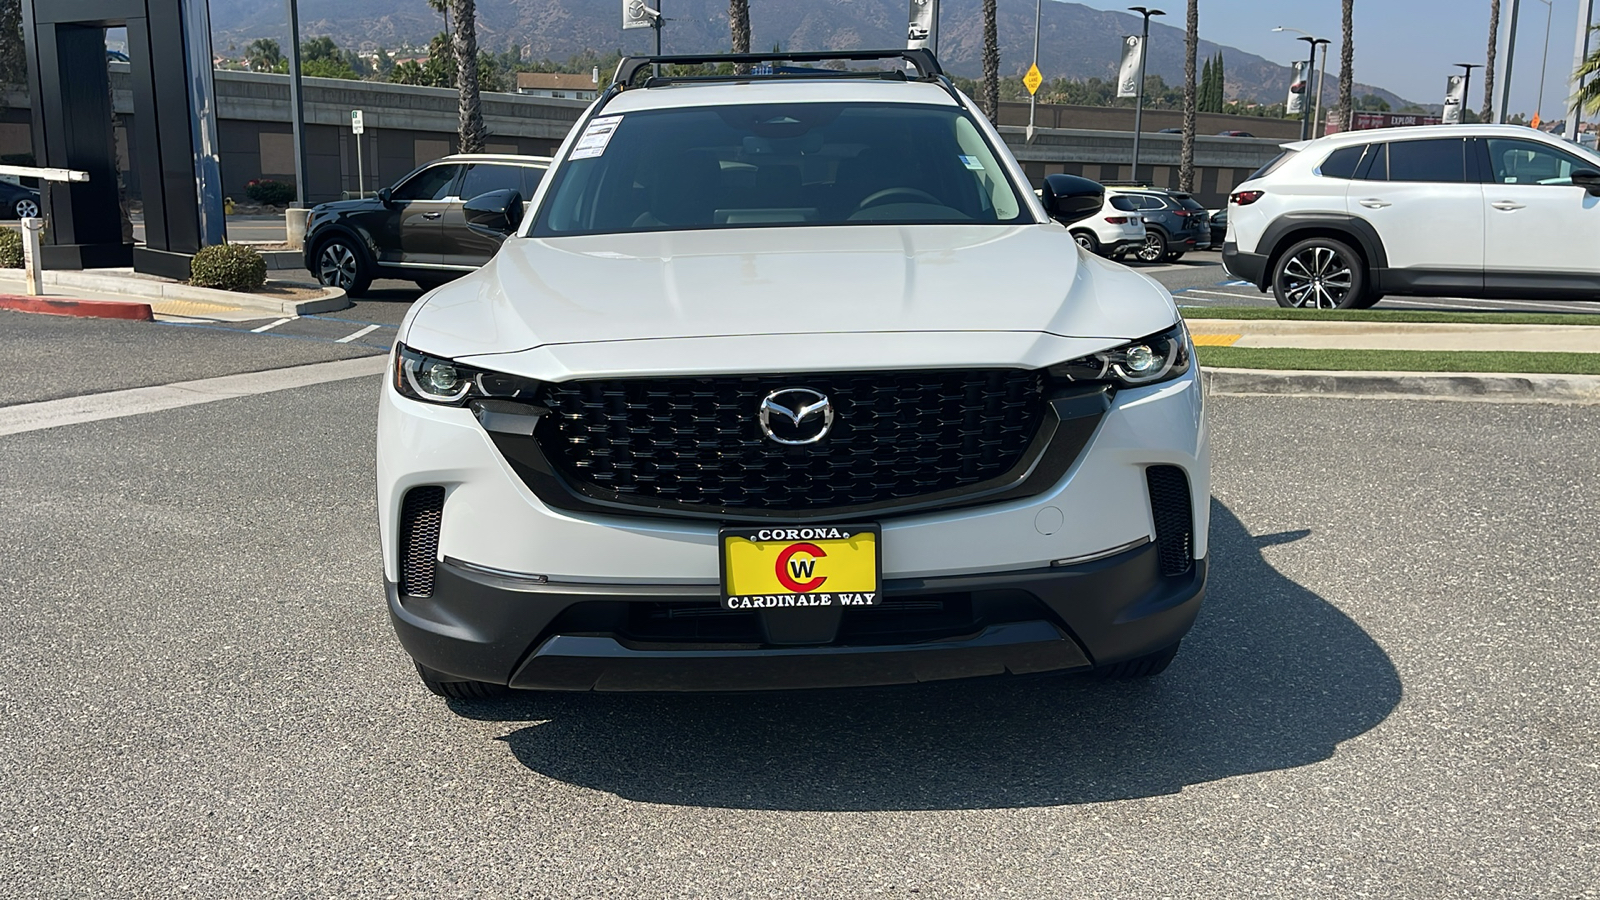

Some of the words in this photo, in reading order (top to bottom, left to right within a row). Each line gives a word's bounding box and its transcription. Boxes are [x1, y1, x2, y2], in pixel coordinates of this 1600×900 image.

[1391, 116, 1416, 125] EXPLORE
[758, 528, 841, 541] CORONA
[727, 594, 832, 609] CARDINALE
[838, 593, 876, 606] WAY
